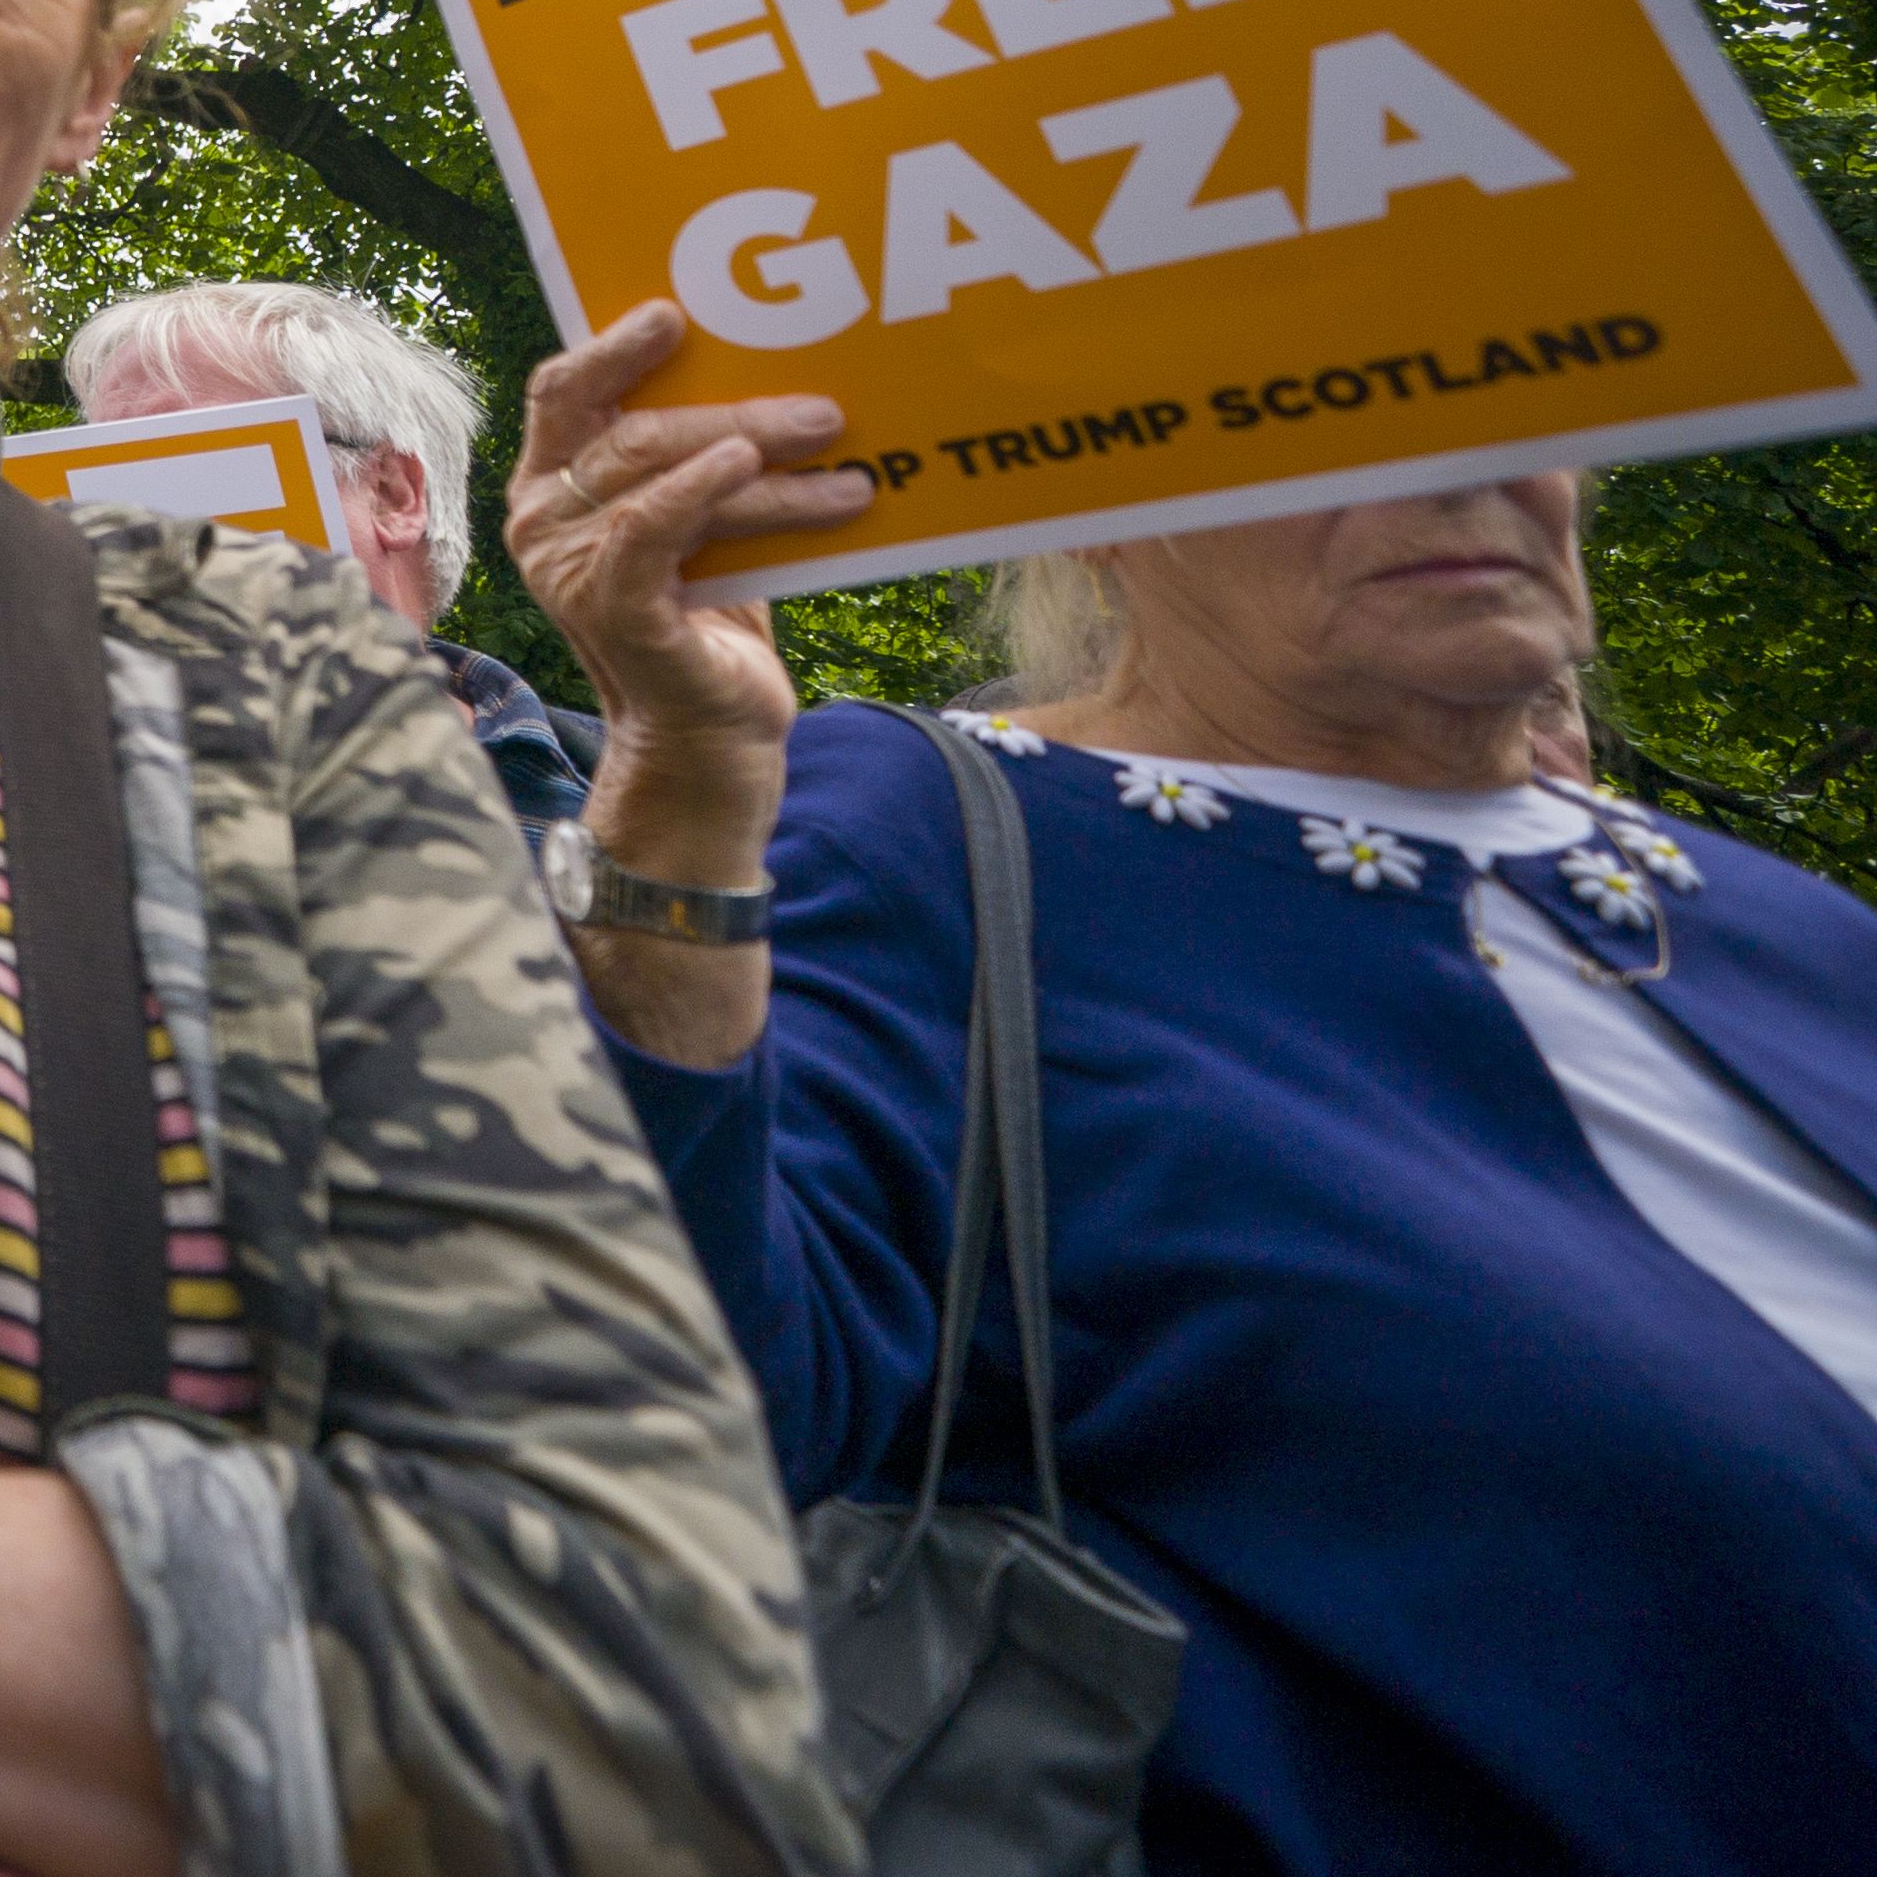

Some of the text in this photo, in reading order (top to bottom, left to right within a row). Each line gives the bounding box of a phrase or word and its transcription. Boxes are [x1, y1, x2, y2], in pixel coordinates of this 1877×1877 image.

[667, 29, 1575, 350] GAZA
[935, 398, 1188, 480] TRUMP
[1208, 313, 1665, 435] SCOTLAND
